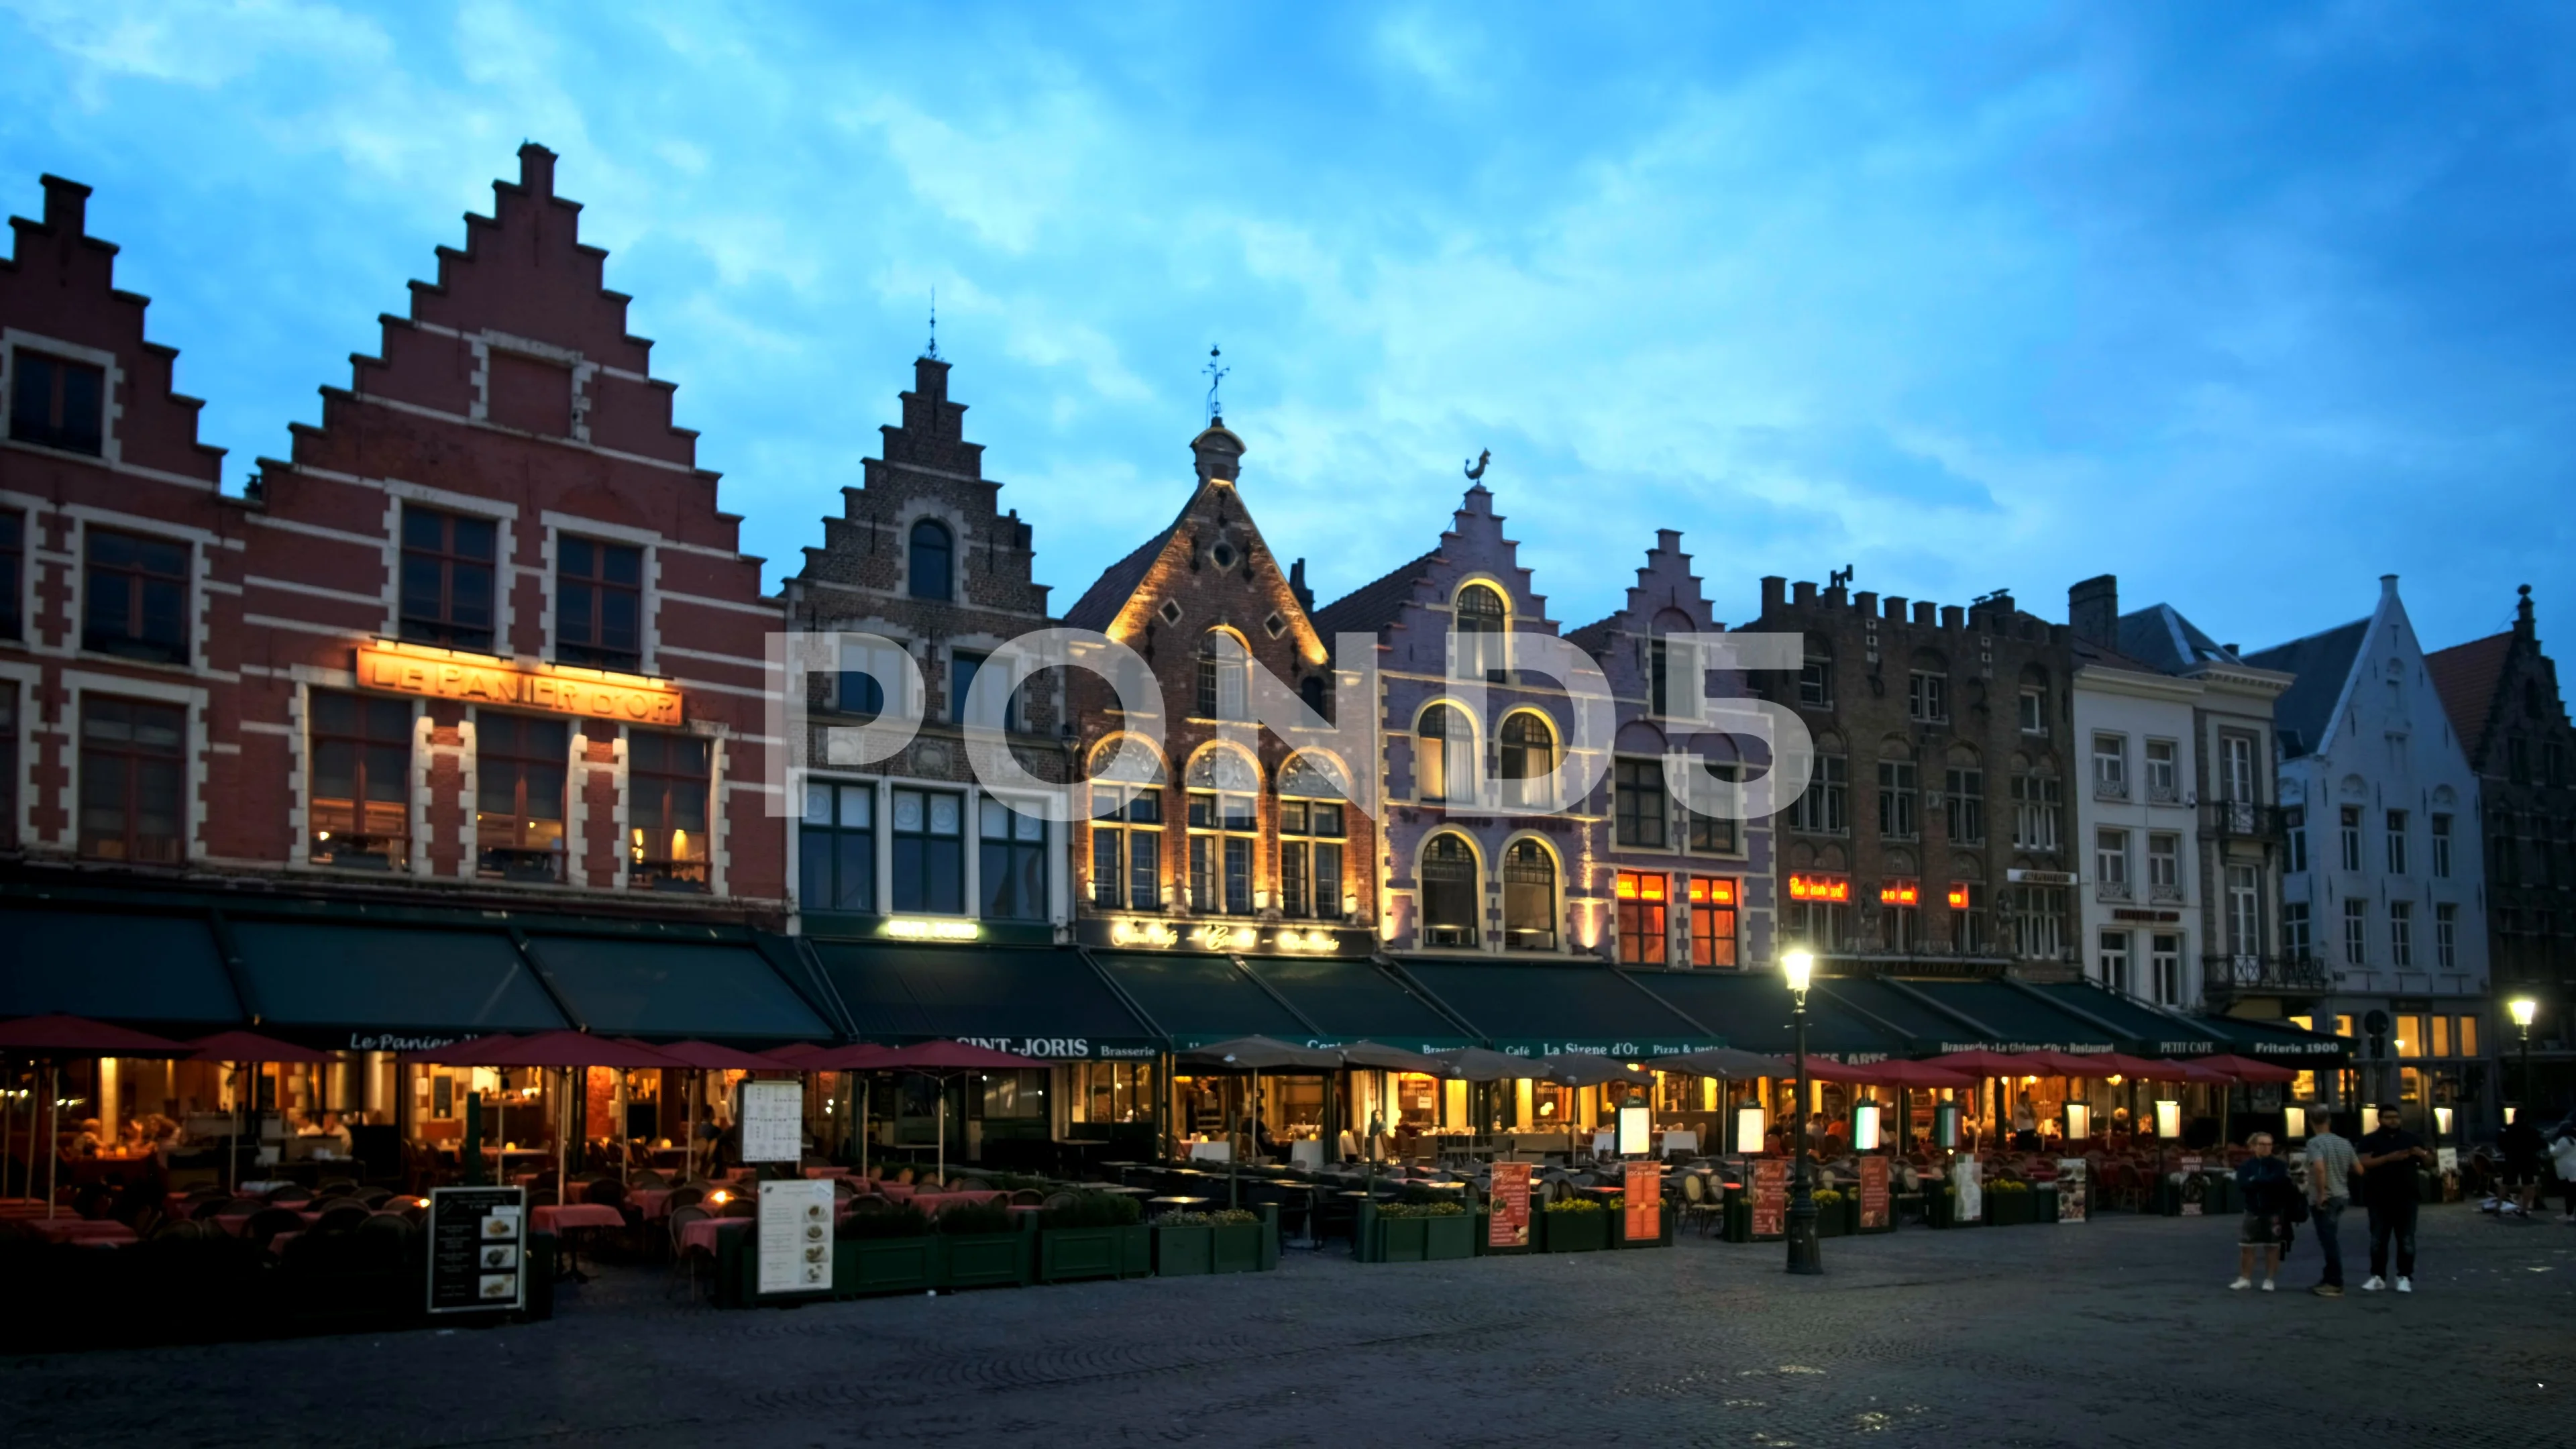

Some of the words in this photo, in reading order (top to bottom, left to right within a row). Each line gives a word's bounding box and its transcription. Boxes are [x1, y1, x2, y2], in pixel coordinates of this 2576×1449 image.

[373, 661, 423, 690] LE
[437, 667, 577, 711] PANIER
[590, 693, 674, 723] D'OR
[350, 1032, 376, 1050] Le
[1100, 1045, 1156, 1057] Brasserie
[1505, 1045, 1530, 1056] Café
[1544, 1044, 1560, 1056] La
[1566, 1043, 1608, 1055] Sirene
[1612, 1042, 1640, 1055] d'Or
[1653, 1044, 1679, 1055] Pizza
[1683, 1044, 1690, 1053] &
[2070, 1042, 2113, 1054] Restaurant
[2160, 1042, 2186, 1053] PETIT
[2255, 1042, 2302, 1054] Friterie
[2306, 1042, 2339, 1054] 1900
